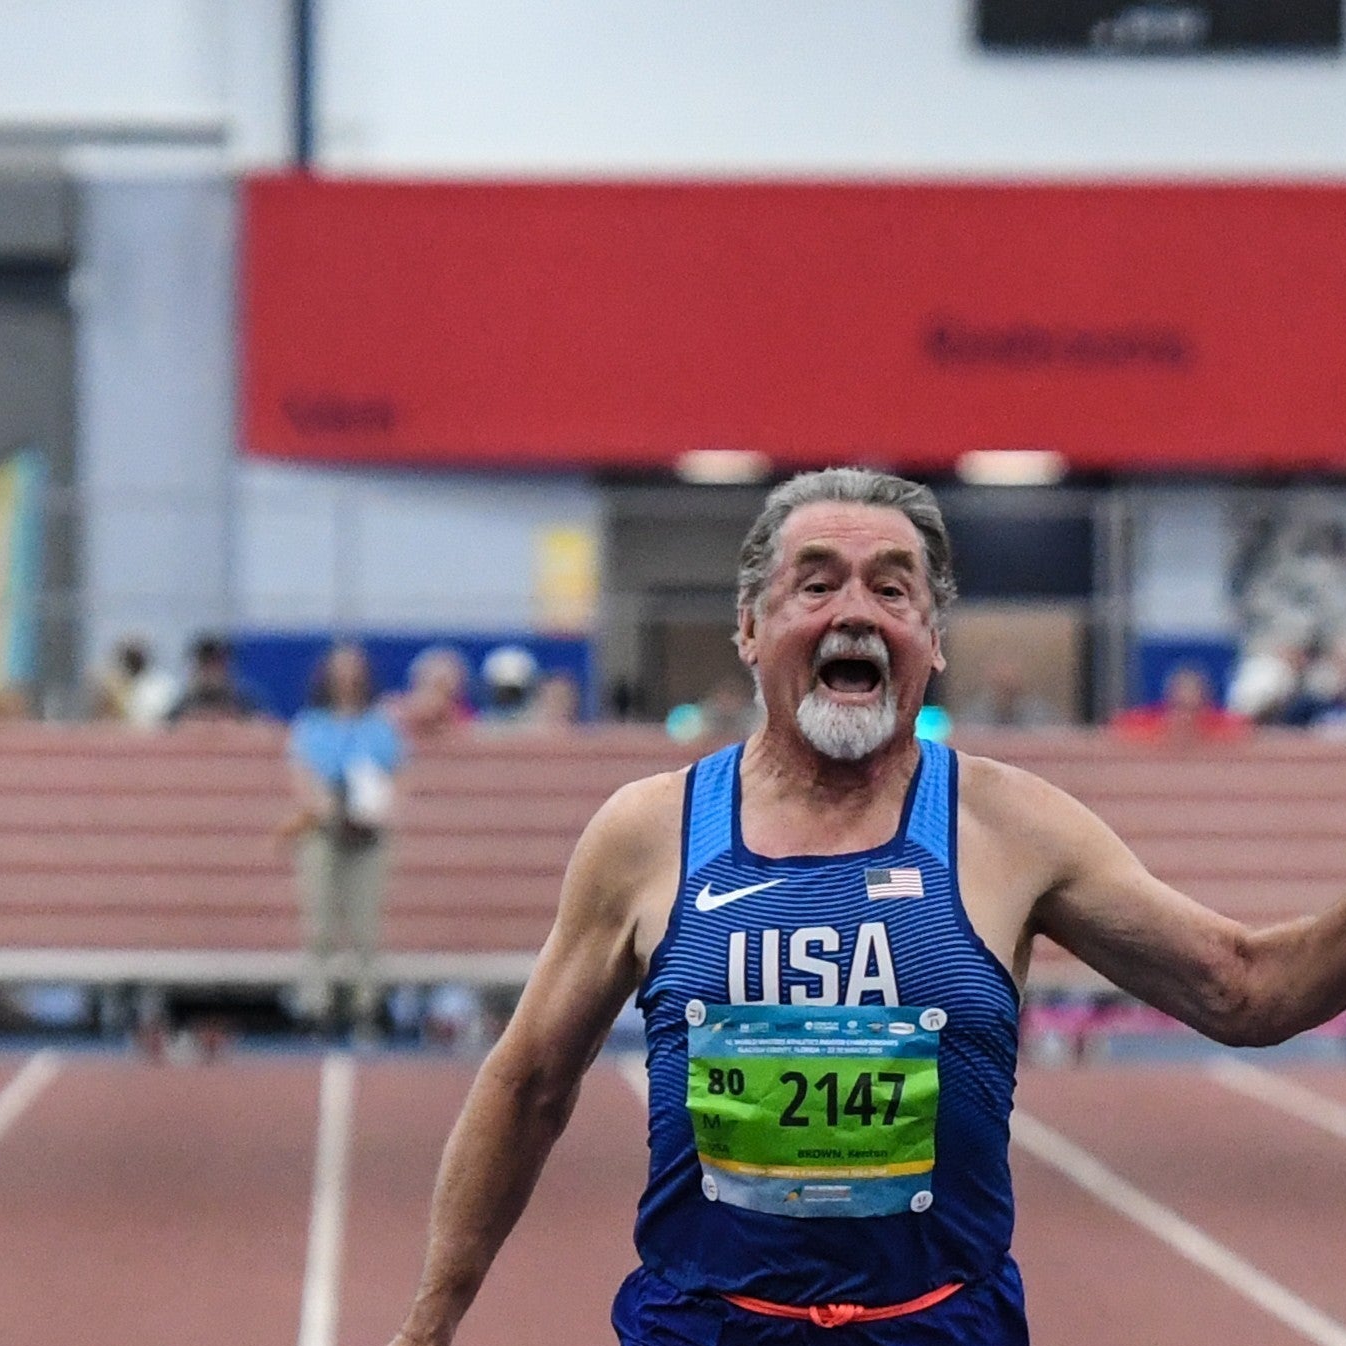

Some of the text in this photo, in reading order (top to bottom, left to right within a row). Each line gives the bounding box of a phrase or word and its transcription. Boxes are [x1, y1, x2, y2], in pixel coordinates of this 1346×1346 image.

[728, 921, 899, 1007] USA
[708, 1067, 745, 1096] 80
[778, 1071, 906, 1127] 2147
[702, 1113, 722, 1130] M
